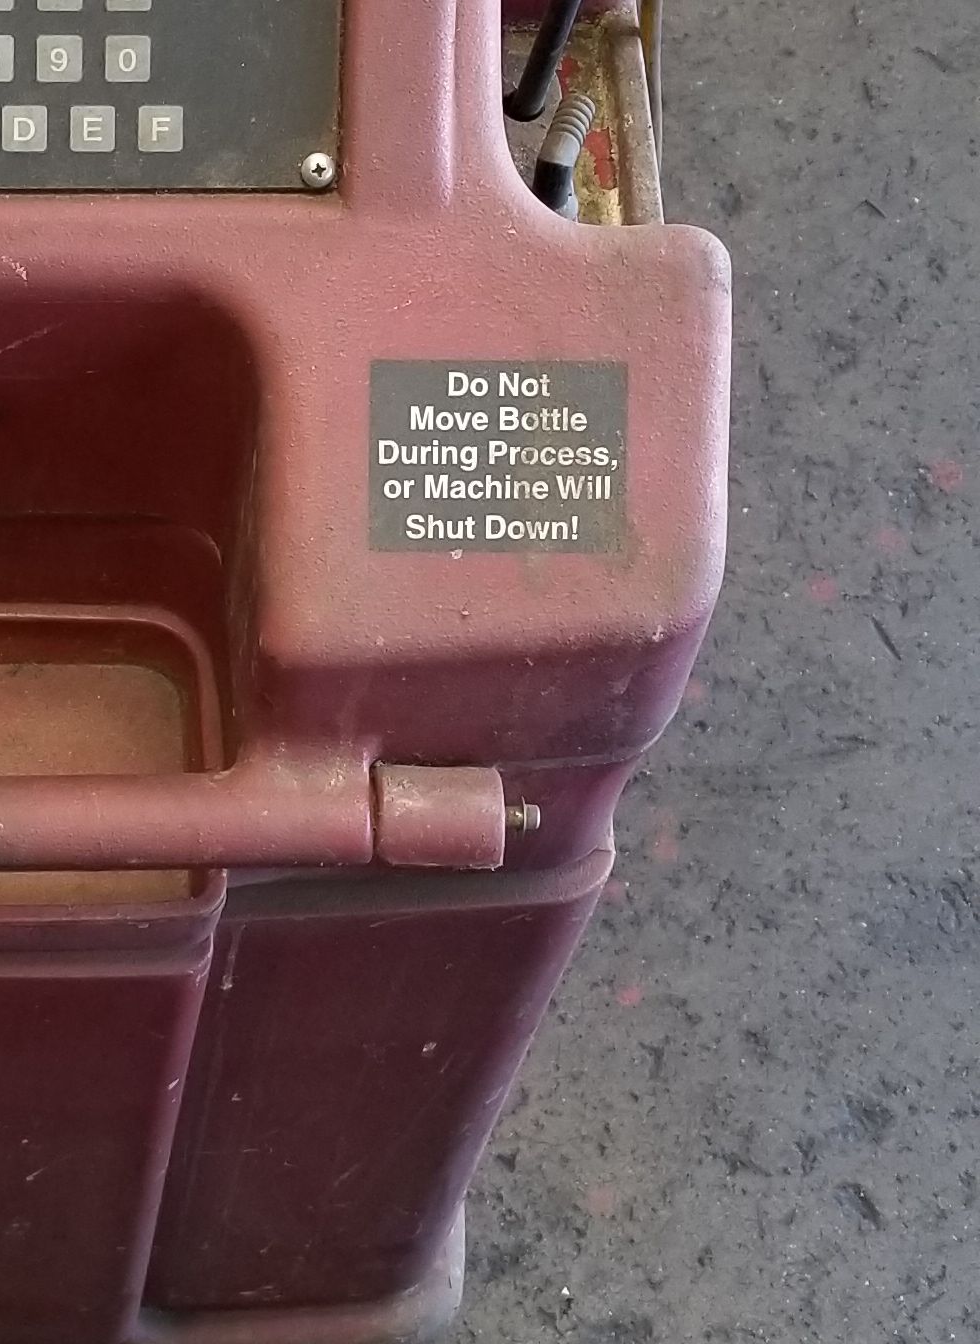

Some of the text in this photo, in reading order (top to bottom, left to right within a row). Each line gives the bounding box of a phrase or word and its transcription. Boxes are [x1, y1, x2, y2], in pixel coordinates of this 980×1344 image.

[49, 48, 69, 71] 9
[119, 48, 137, 71] 0
[13, 117, 36, 140] D
[83, 118, 102, 141] E
[151, 118, 170, 141] F
[448, 371, 550, 397] Do Not
[410, 406, 588, 432] Move Bottle
[378, 440, 618, 471] During Process,
[384, 475, 611, 500] or Machine Will
[406, 515, 579, 540] Shut Down!
